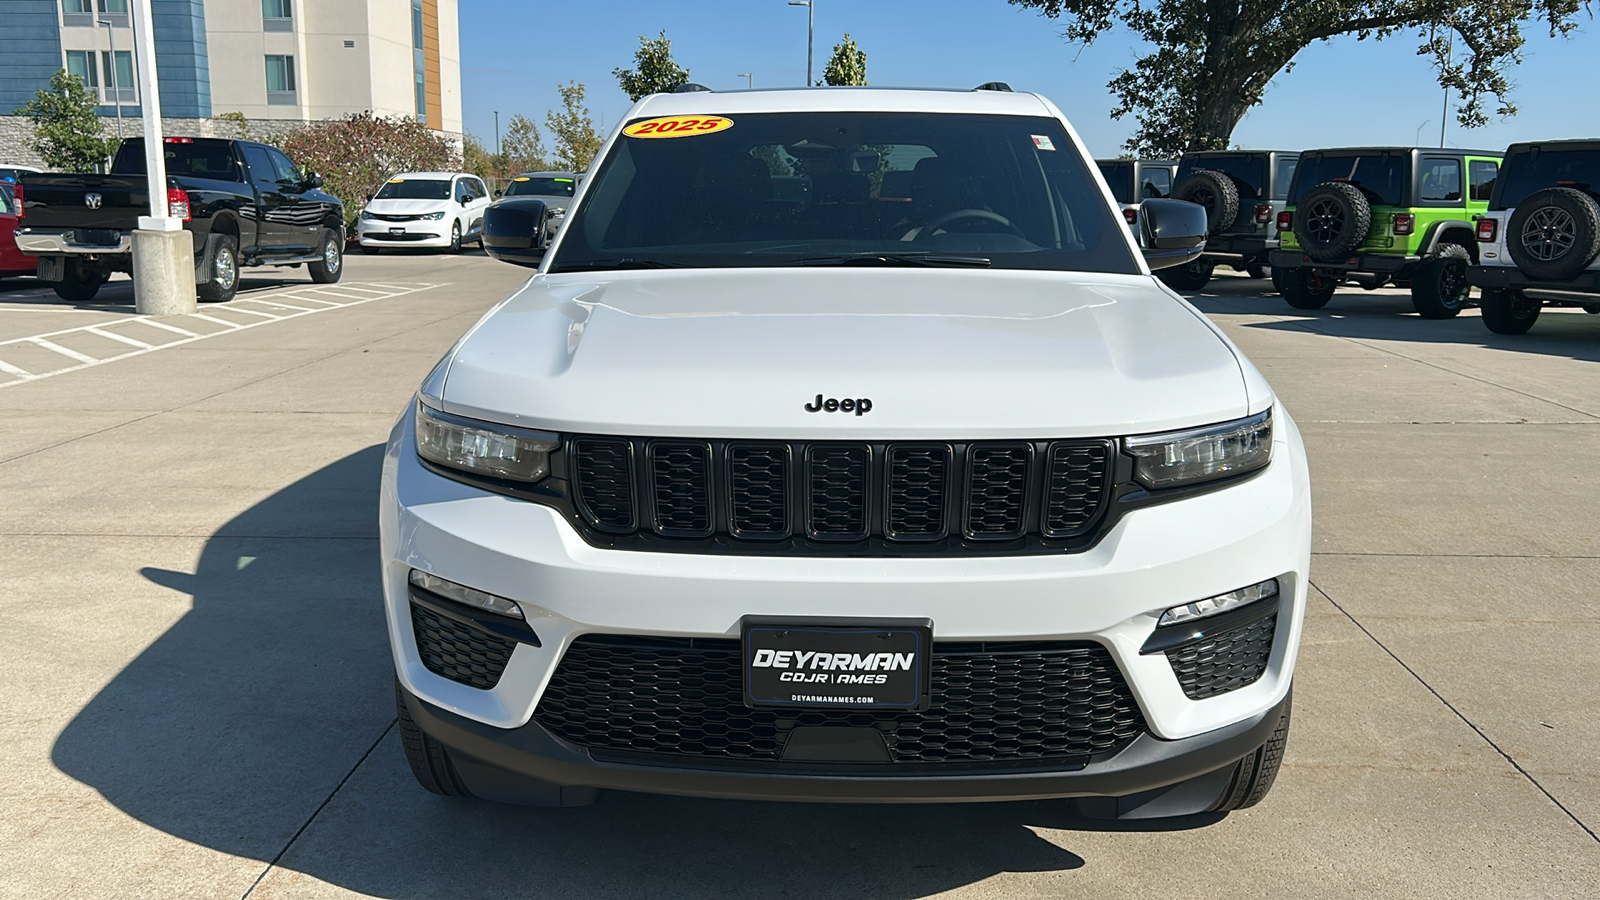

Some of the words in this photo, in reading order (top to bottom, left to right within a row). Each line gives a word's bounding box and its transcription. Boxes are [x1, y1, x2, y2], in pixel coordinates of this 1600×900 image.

[633, 119, 723, 134] 2025
[804, 394, 873, 416] Jeep
[752, 649, 915, 671] DEYARMAN
[836, 674, 888, 684] AMES
[791, 694, 874, 704] DEYARMANAMES.COM
